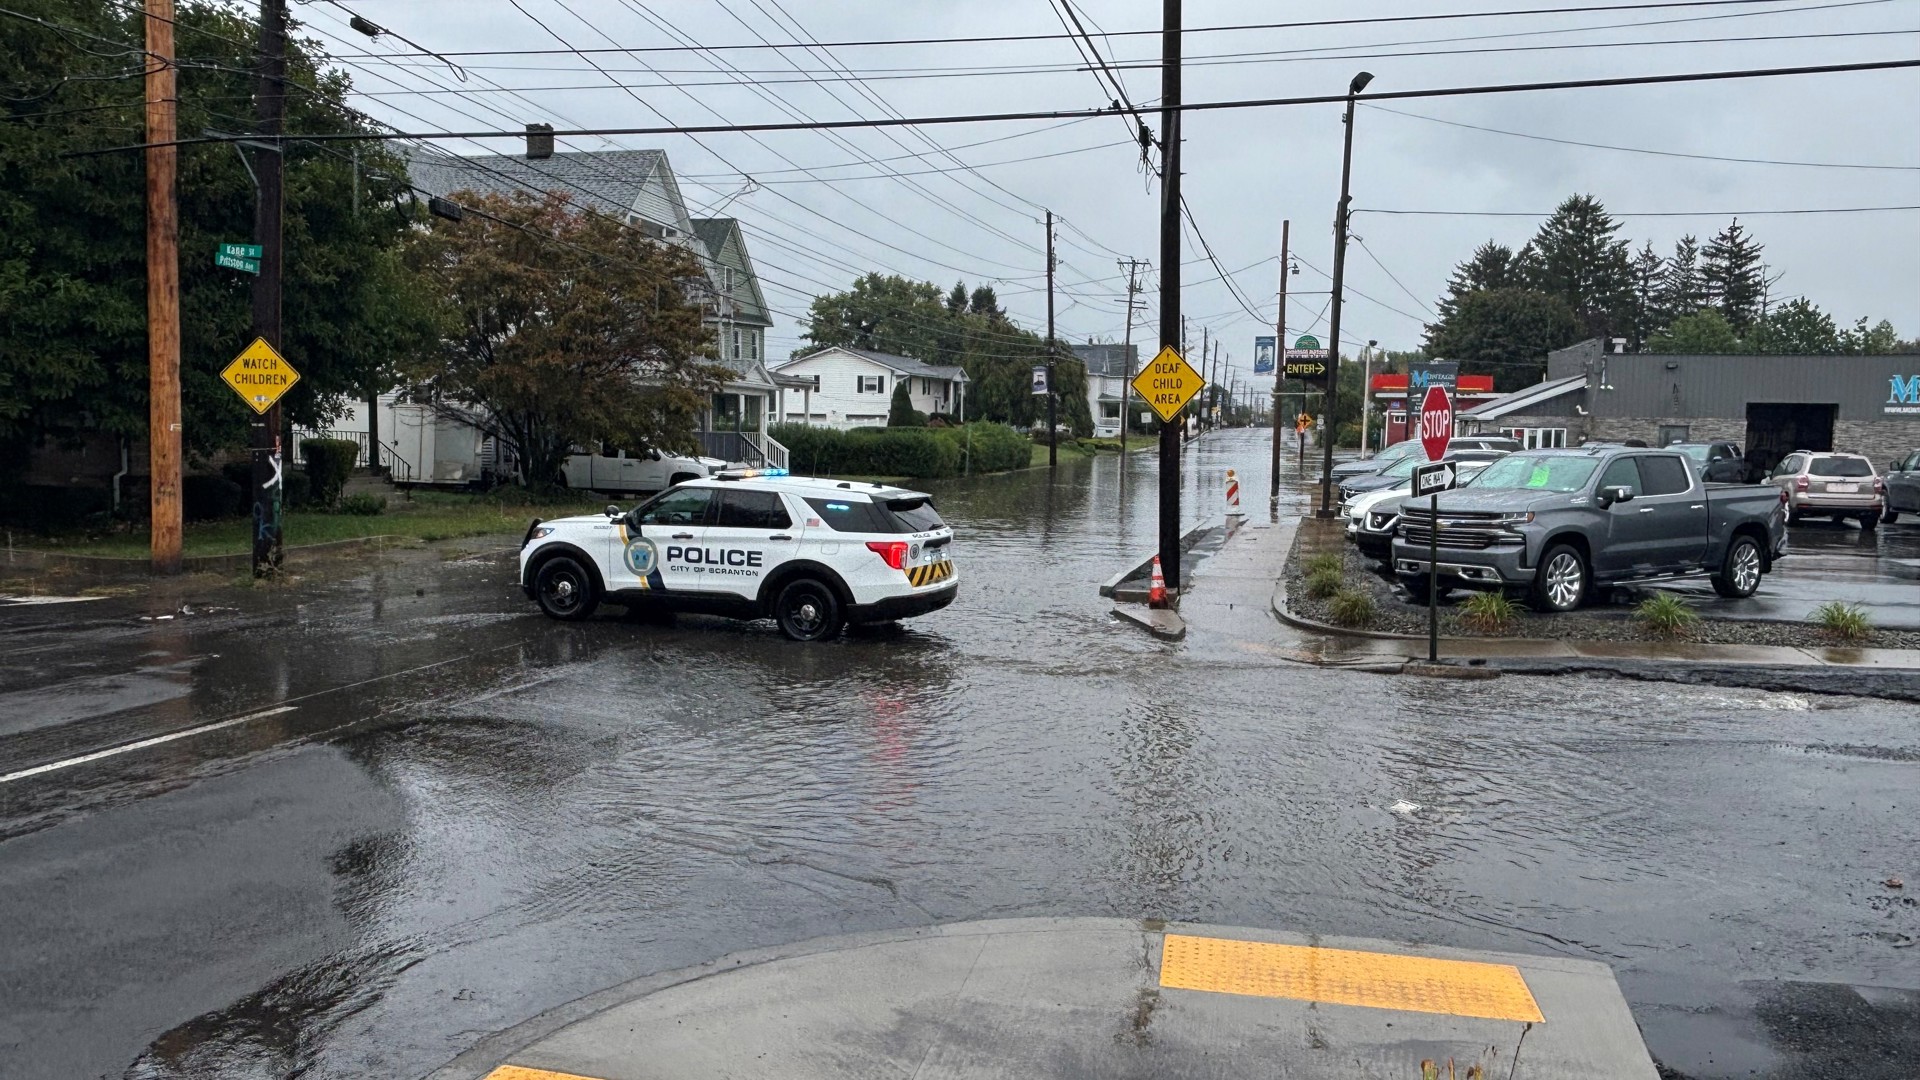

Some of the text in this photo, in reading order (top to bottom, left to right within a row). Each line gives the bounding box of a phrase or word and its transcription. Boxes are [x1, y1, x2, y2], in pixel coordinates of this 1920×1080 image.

[226, 244, 245, 255] Kane
[243, 358, 277, 370] WATCH
[1155, 363, 1181, 374] DEAF
[1287, 364, 1315, 374] ENTER
[234, 373, 287, 386] CHILDREN
[1153, 378, 1182, 389] CHILD
[1154, 393, 1181, 404] AREA
[1423, 409, 1450, 440] STOP
[1421, 473, 1444, 488] ONE WAY
[667, 546, 763, 568] POLICE
[670, 565, 690, 573] CITY
[708, 567, 759, 577] SCRANTON
